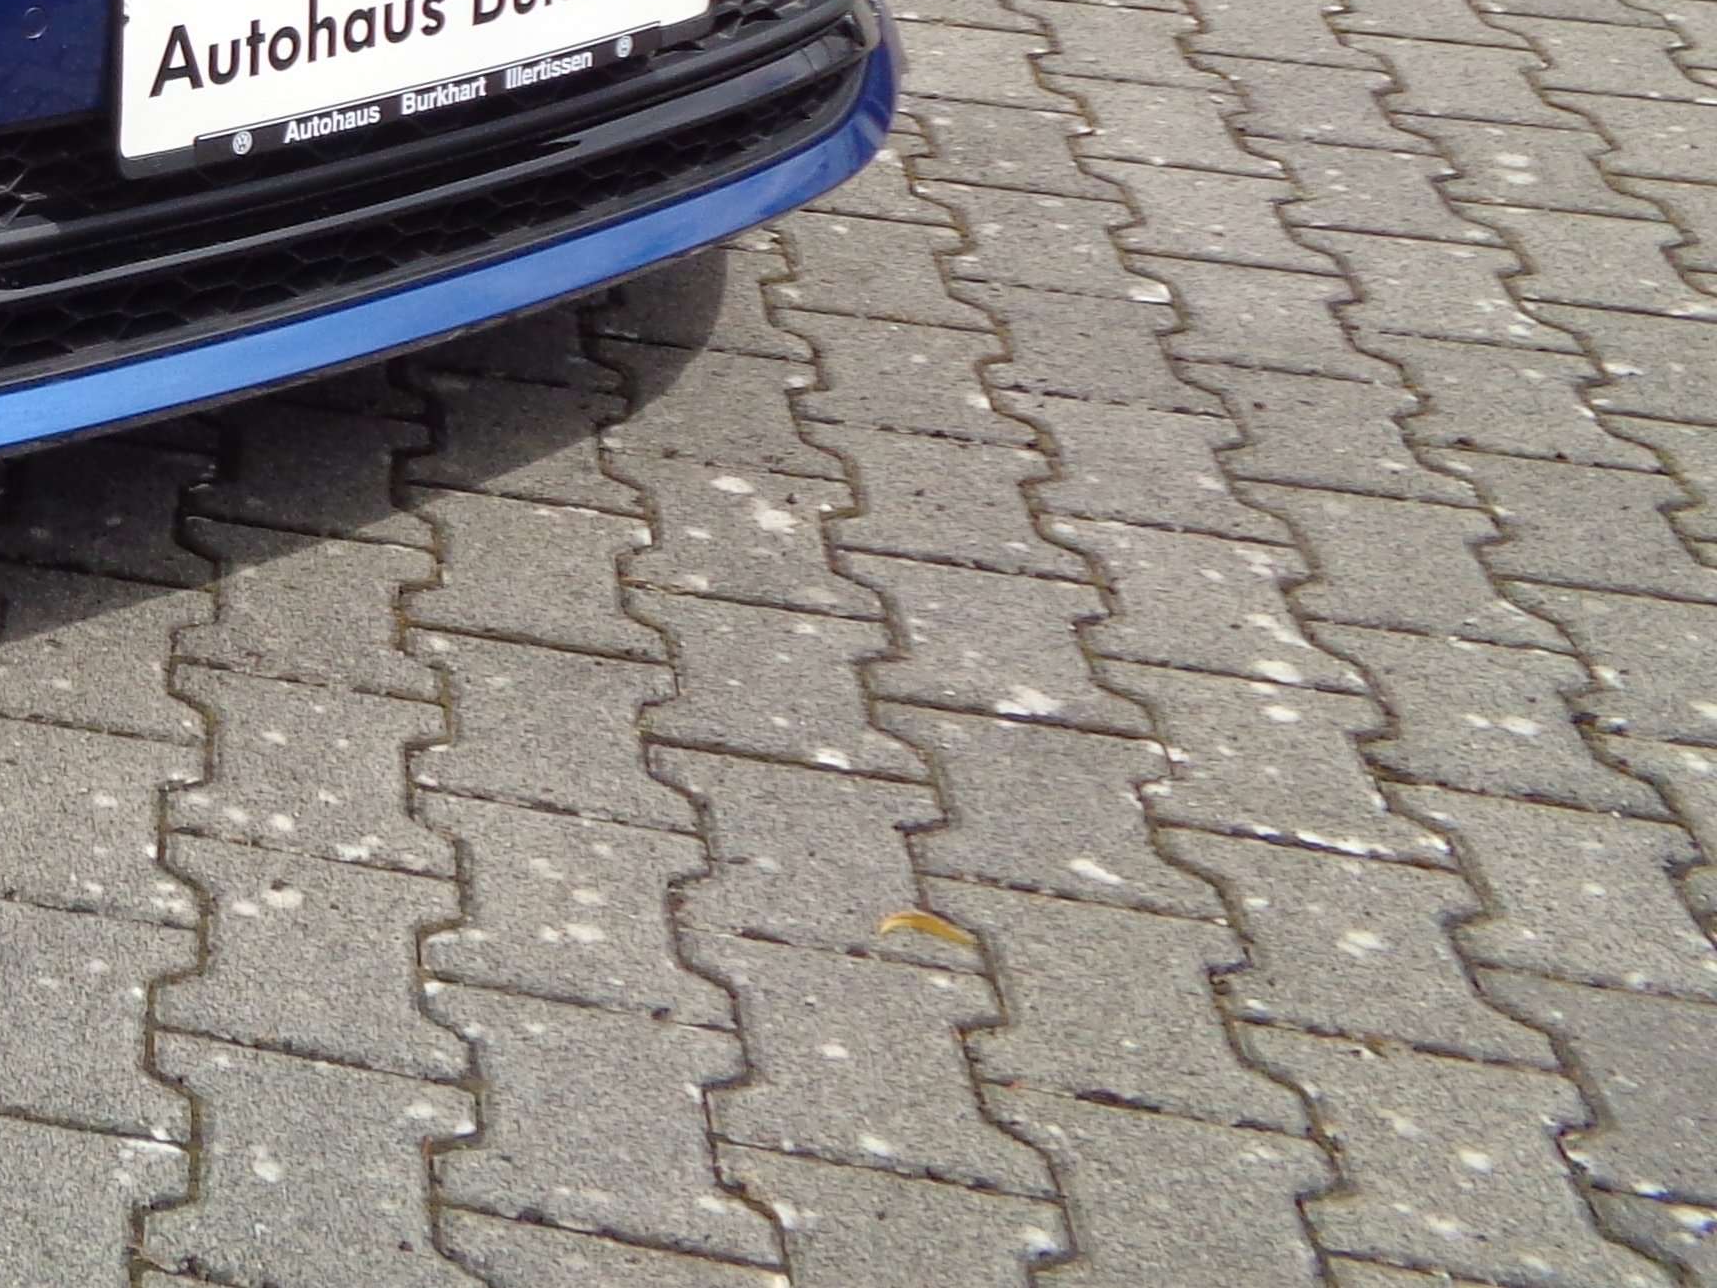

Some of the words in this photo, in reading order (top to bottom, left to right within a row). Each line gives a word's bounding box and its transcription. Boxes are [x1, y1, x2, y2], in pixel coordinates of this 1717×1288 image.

[283, 103, 382, 144] Autohaus
[401, 76, 488, 115] Burkhart
[504, 51, 594, 90] Illertissen
